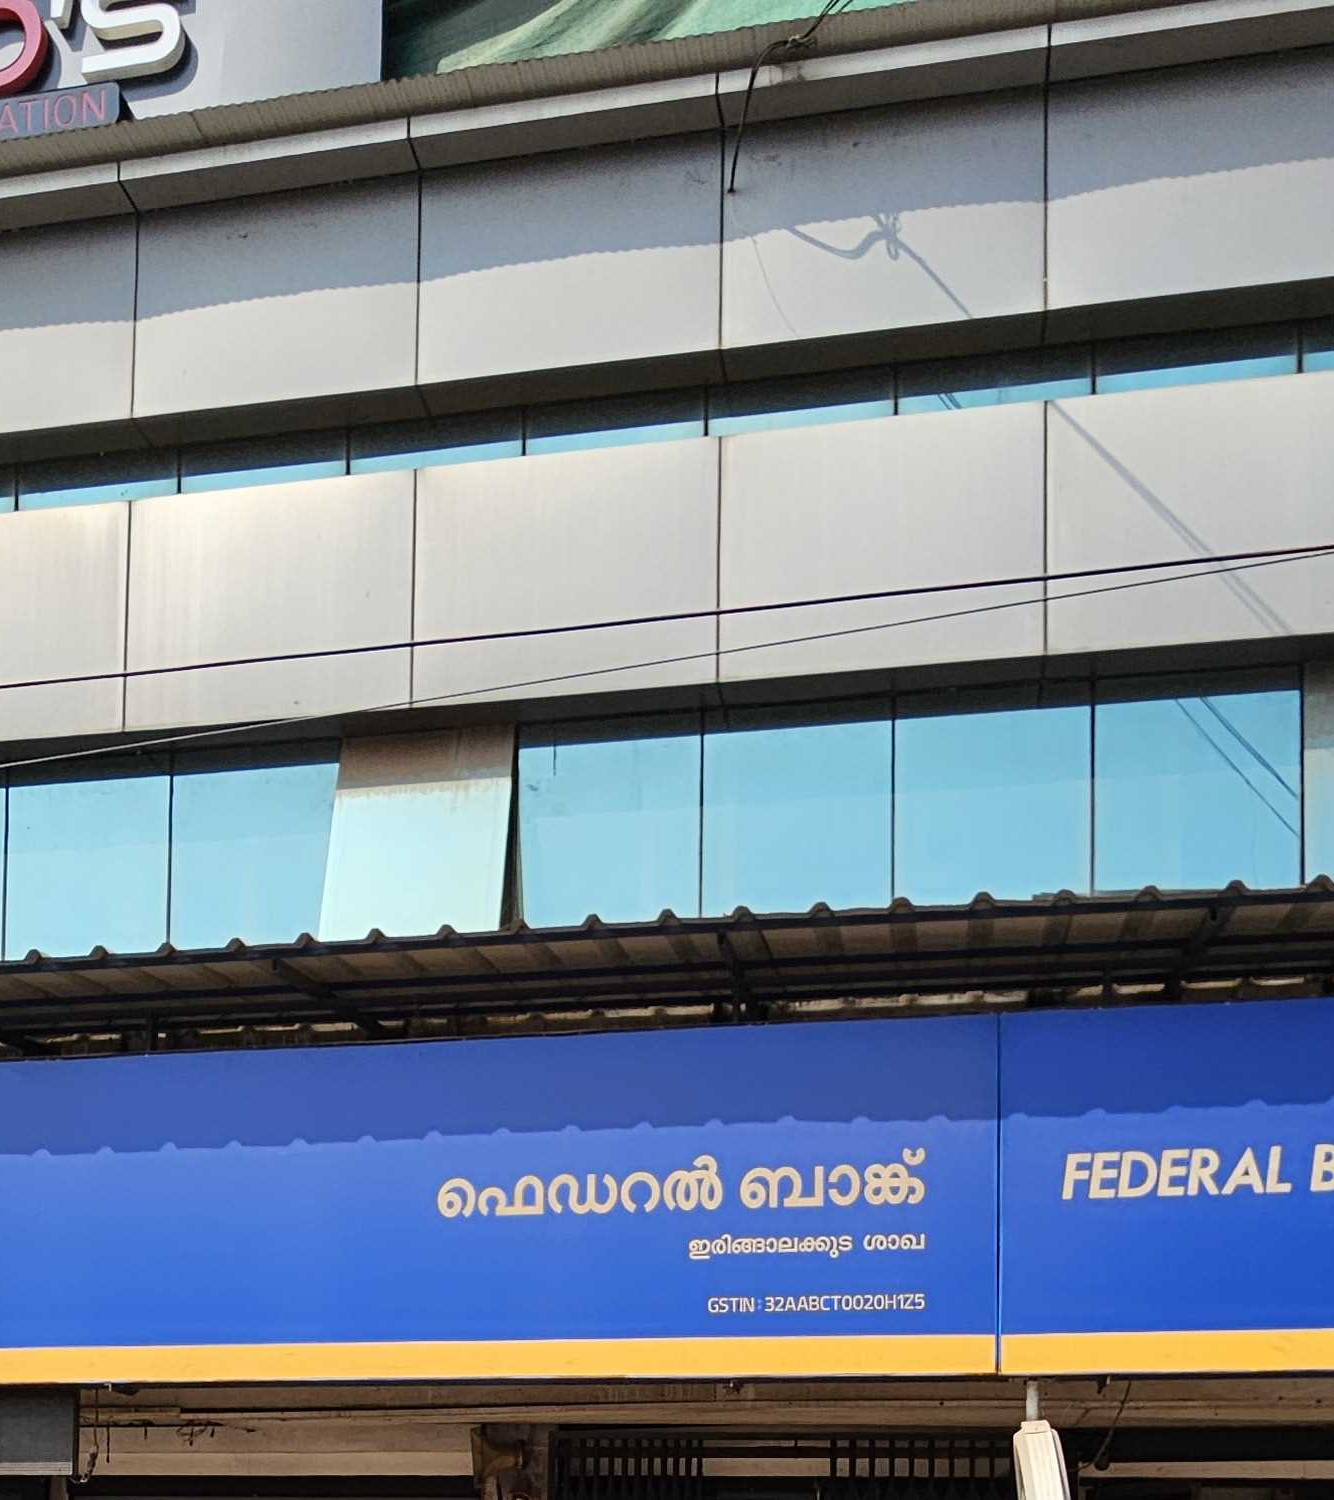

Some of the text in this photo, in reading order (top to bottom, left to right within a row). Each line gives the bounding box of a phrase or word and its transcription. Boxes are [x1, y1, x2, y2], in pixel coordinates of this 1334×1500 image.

[437, 1147, 927, 1219] ഫെഡറൽ ബാങ്ക്
[1062, 1142, 1292, 1201] FEDERAL
[688, 1232, 926, 1261] ഇരിങ്ങാലക്കുട ശാഖ
[707, 1295, 755, 1314] GSTIN
